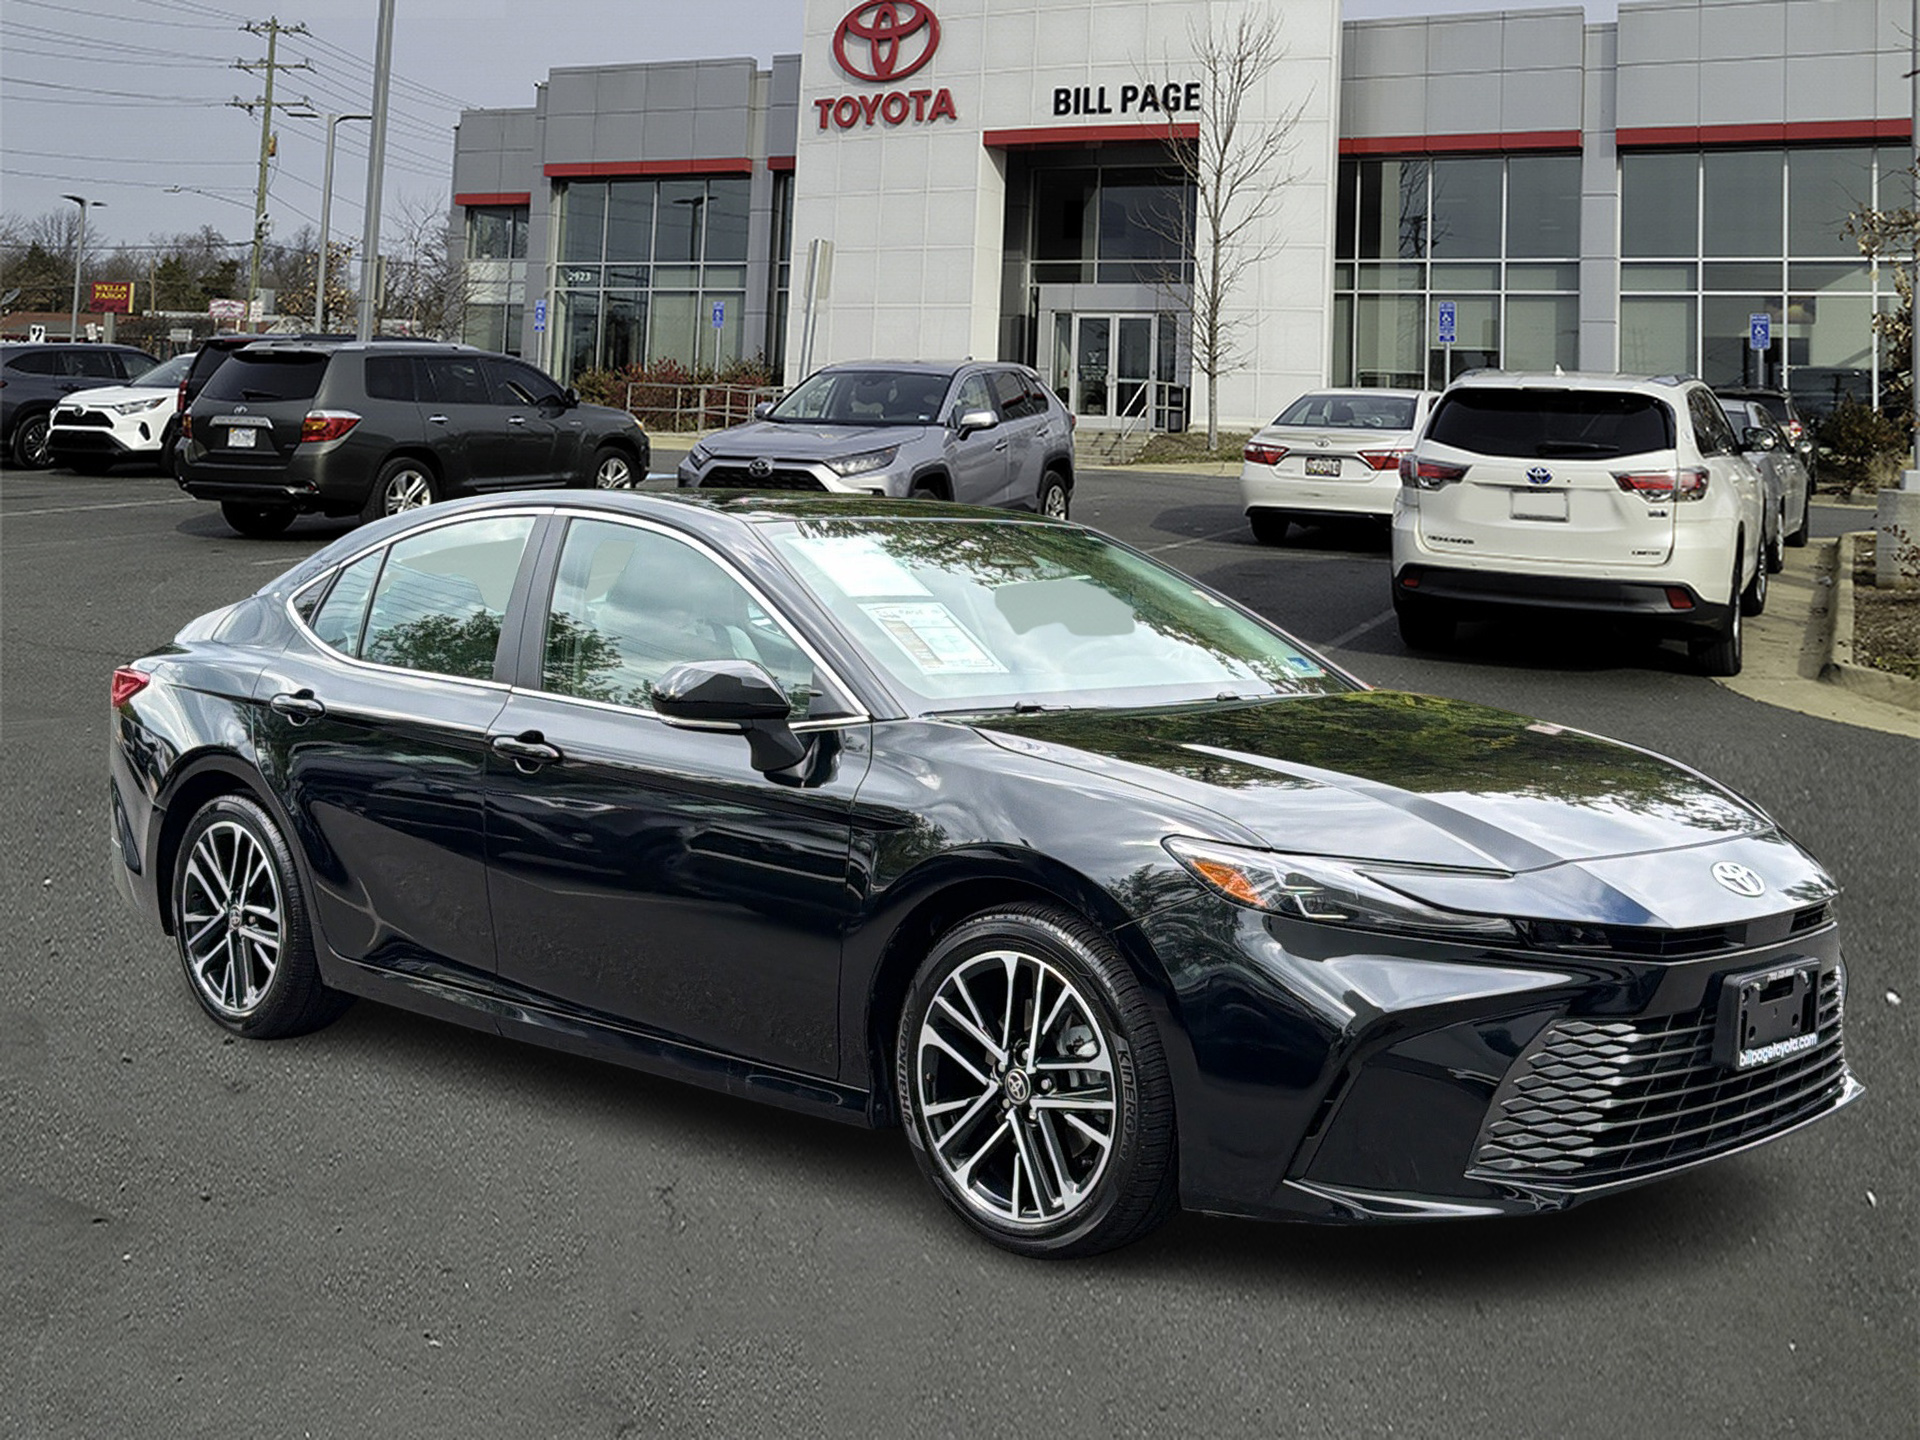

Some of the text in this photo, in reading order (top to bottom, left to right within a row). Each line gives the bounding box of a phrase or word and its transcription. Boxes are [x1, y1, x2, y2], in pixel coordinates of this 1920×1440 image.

[814, 88, 957, 129] TOYOTA
[1053, 82, 1200, 115] BILL PAGE
[94, 284, 128, 292] WELLS
[94, 292, 128, 300] FARGO
[1739, 1033, 1817, 1067] billpagetoyota.com
